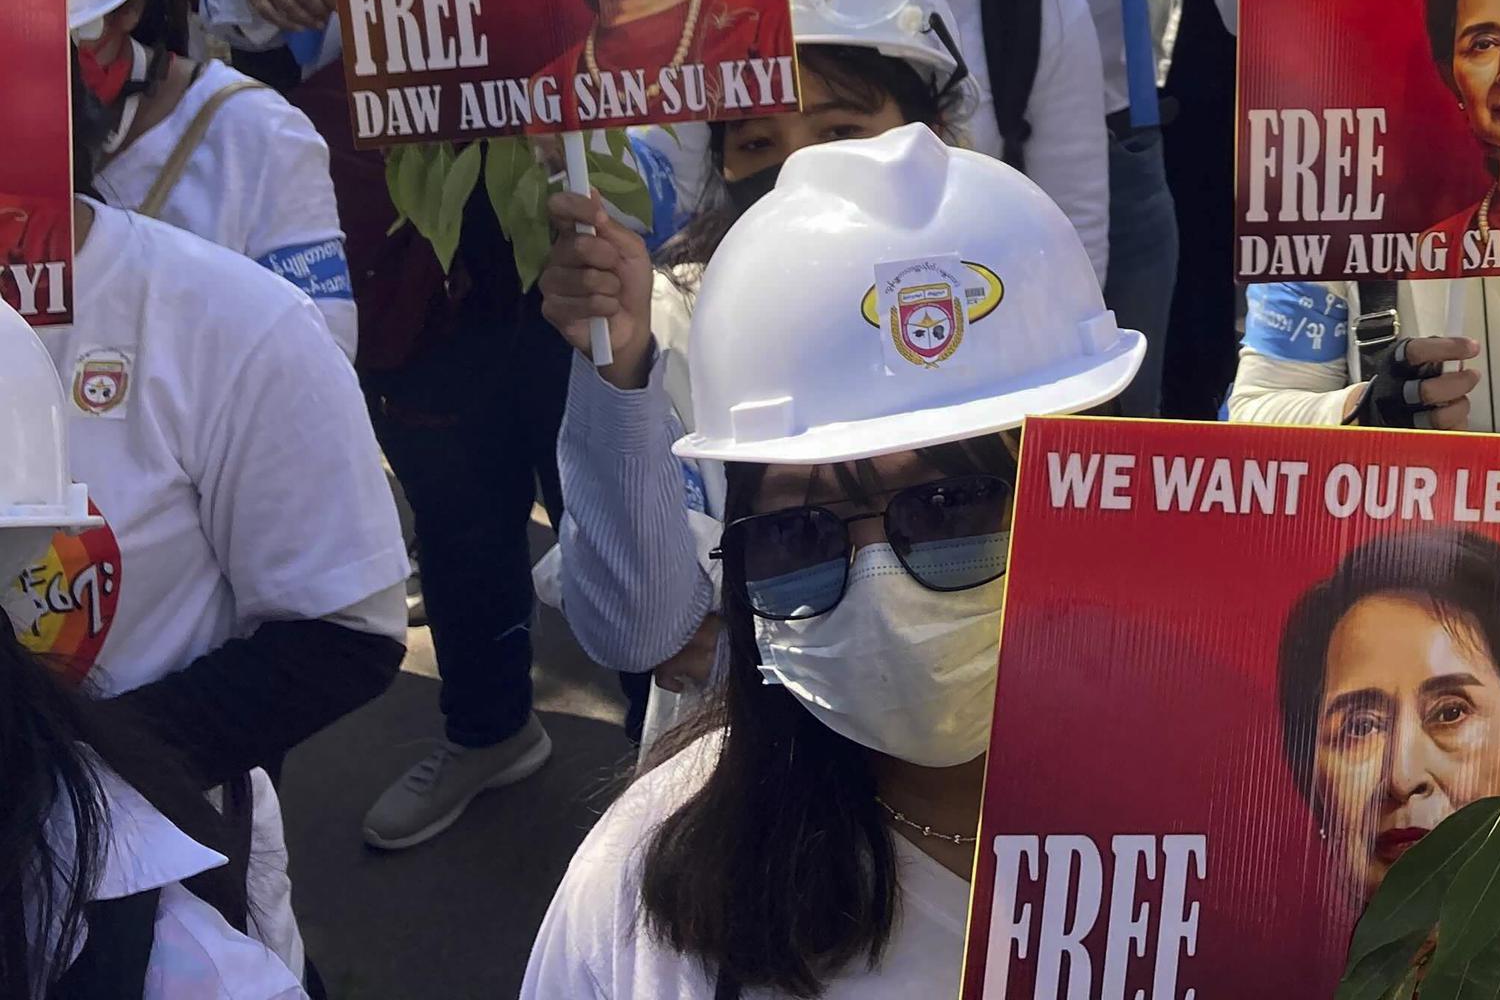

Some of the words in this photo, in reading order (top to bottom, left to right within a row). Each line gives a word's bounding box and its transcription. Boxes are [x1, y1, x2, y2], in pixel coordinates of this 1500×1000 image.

[352, 83, 443, 140] DAW
[458, 75, 563, 131] AUNG
[577, 66, 651, 122] SAN
[658, 62, 712, 114] SU
[721, 55, 798, 110] KYI
[1245, 108, 1388, 223] FREE
[0, 261, 67, 315] YI
[1239, 234, 1330, 277] DAW
[1343, 231, 1449, 274] AUNG
[1046, 451, 1136, 510] WE
[1151, 456, 1310, 515] WANT
[1324, 463, 1436, 521] OUR
[983, 833, 1208, 1000] FREE
